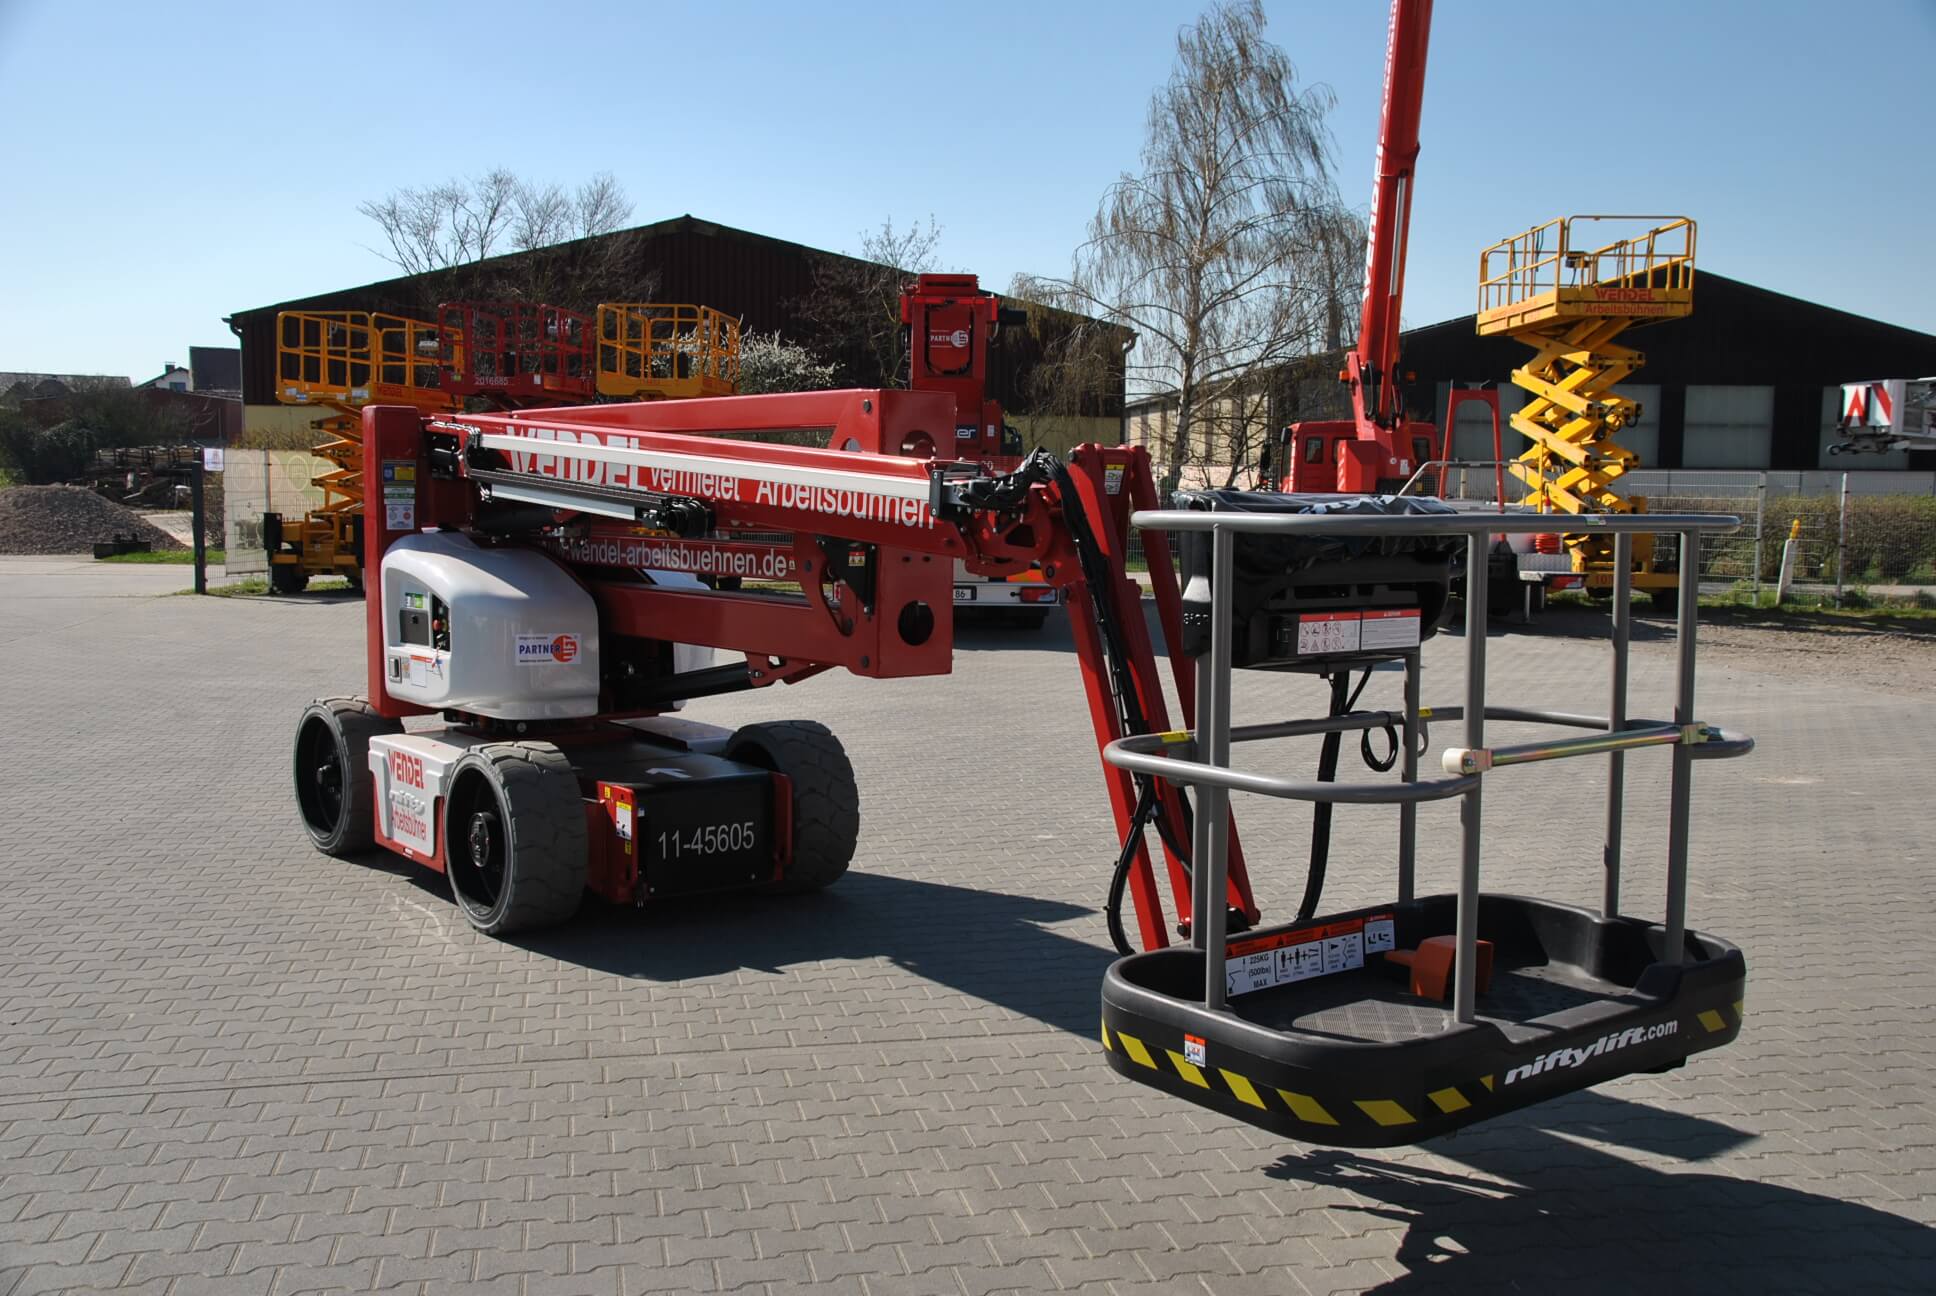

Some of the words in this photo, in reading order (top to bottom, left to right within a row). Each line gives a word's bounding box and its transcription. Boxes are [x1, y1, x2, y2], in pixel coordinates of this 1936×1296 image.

[1595, 288, 1655, 301] WENDEL
[506, 425, 649, 492] WENDEL
[519, 643, 561, 655] PARTNER
[387, 748, 425, 790] WENDEL
[658, 821, 755, 860] 11-45605
[1253, 978, 1268, 989] MAX
[1504, 1019, 1679, 1085] niftylift.com
